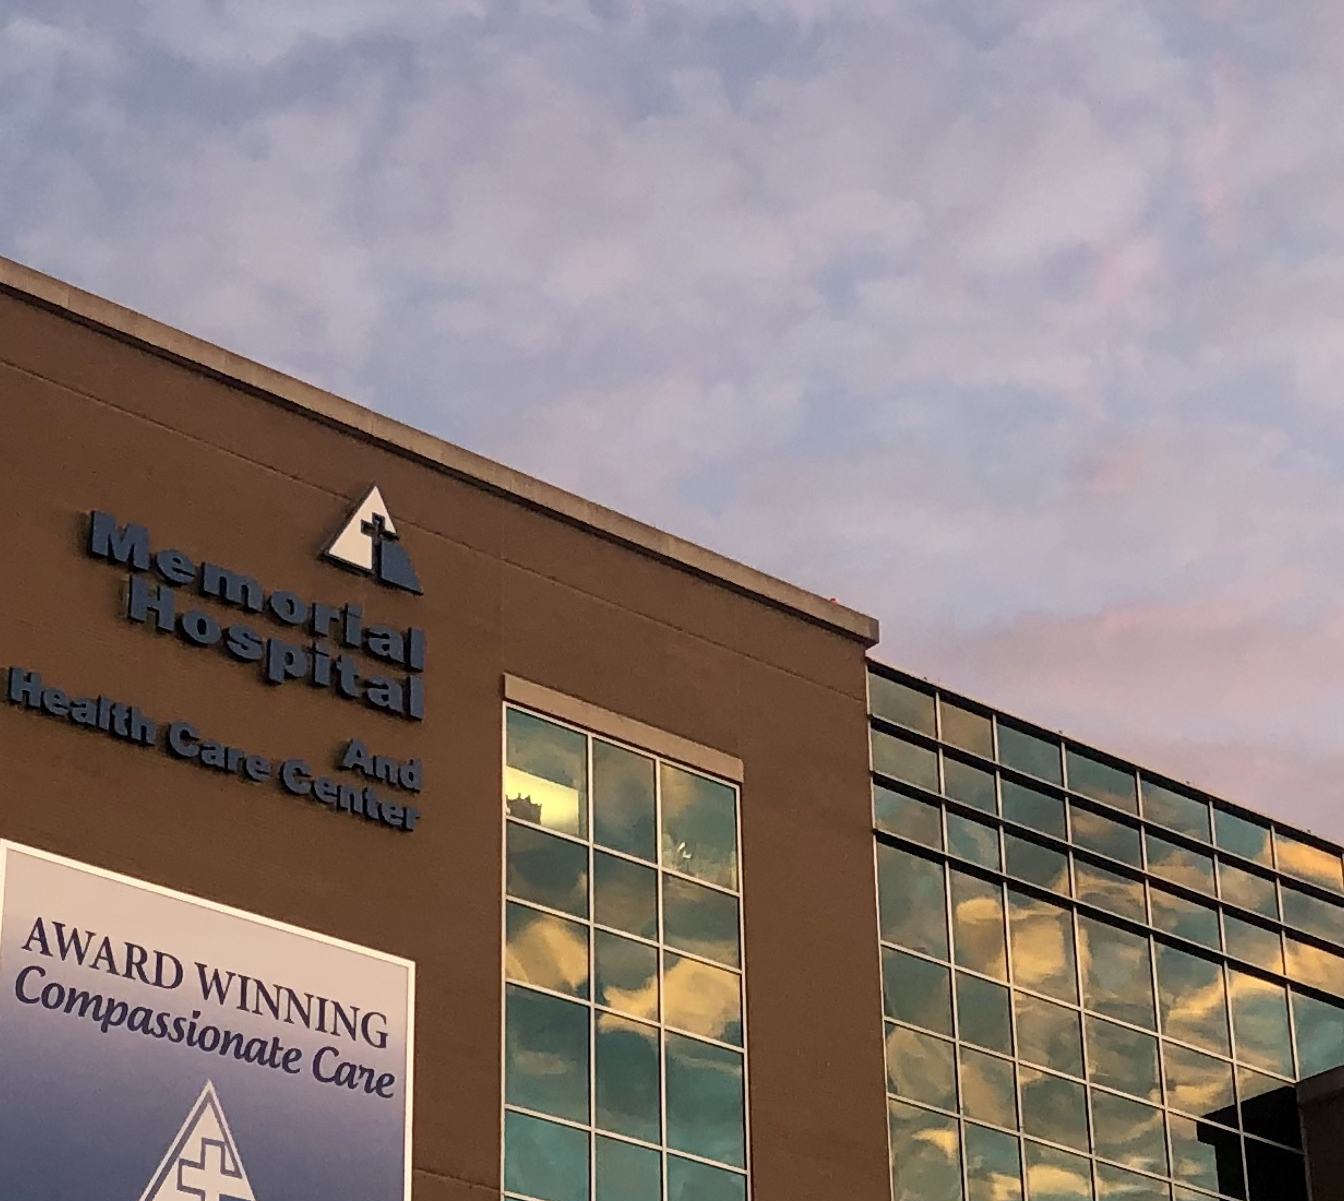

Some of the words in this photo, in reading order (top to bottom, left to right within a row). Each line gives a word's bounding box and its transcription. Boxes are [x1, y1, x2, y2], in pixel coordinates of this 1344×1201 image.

[90, 510, 424, 671] Memorial
[127, 574, 423, 720] Hospital
[8, 666, 156, 745] Health
[167, 722, 271, 783] Care
[280, 759, 421, 831] Center
[340, 739, 422, 792] And
[15, 965, 303, 1074] Compassionate
[312, 1046, 396, 1099] Care
[22, 917, 184, 990] AWARD
[194, 962, 388, 1049] WINNING
